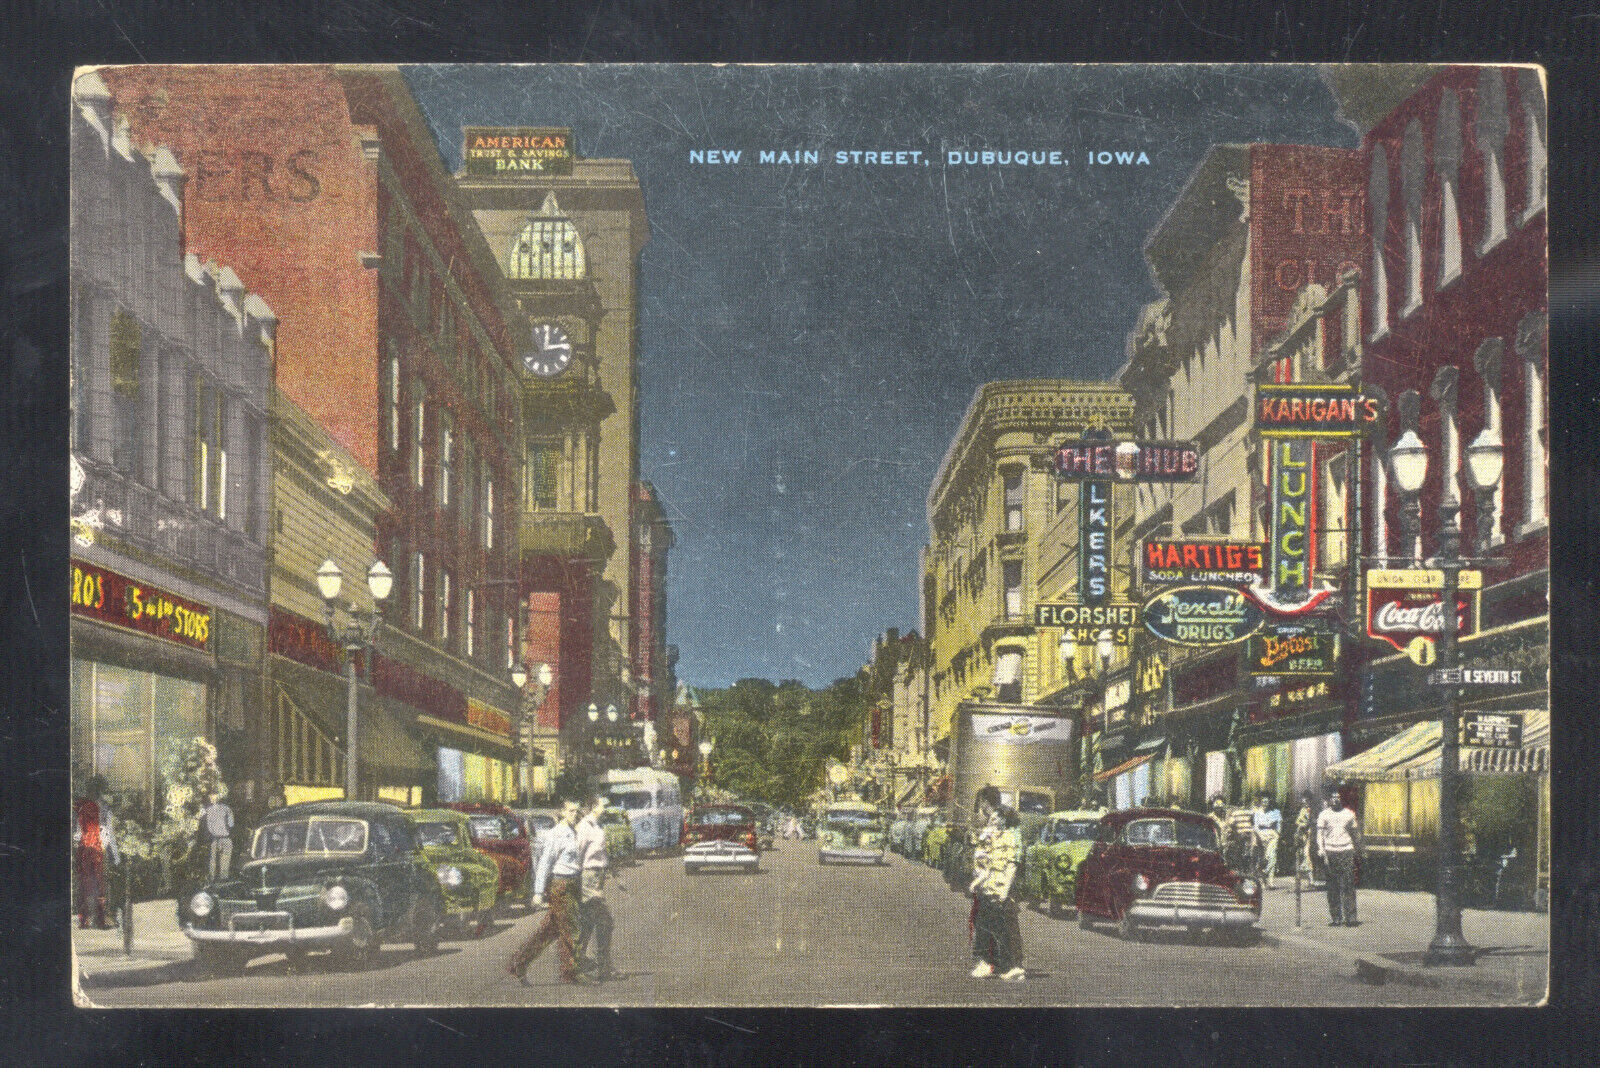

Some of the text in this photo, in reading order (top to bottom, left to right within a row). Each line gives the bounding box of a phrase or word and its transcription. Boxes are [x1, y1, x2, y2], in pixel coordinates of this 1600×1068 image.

[475, 136, 566, 148] AMERICAN
[495, 159, 544, 170] BANK
[1262, 396, 1378, 421] KARIGAN'S
[1059, 446, 1198, 474] THE HUB
[1280, 442, 1306, 585] LUNCH
[1148, 543, 1262, 568] HARTIG'S
[1160, 594, 1247, 624] Rexall
[1176, 624, 1235, 640] DRUGS
